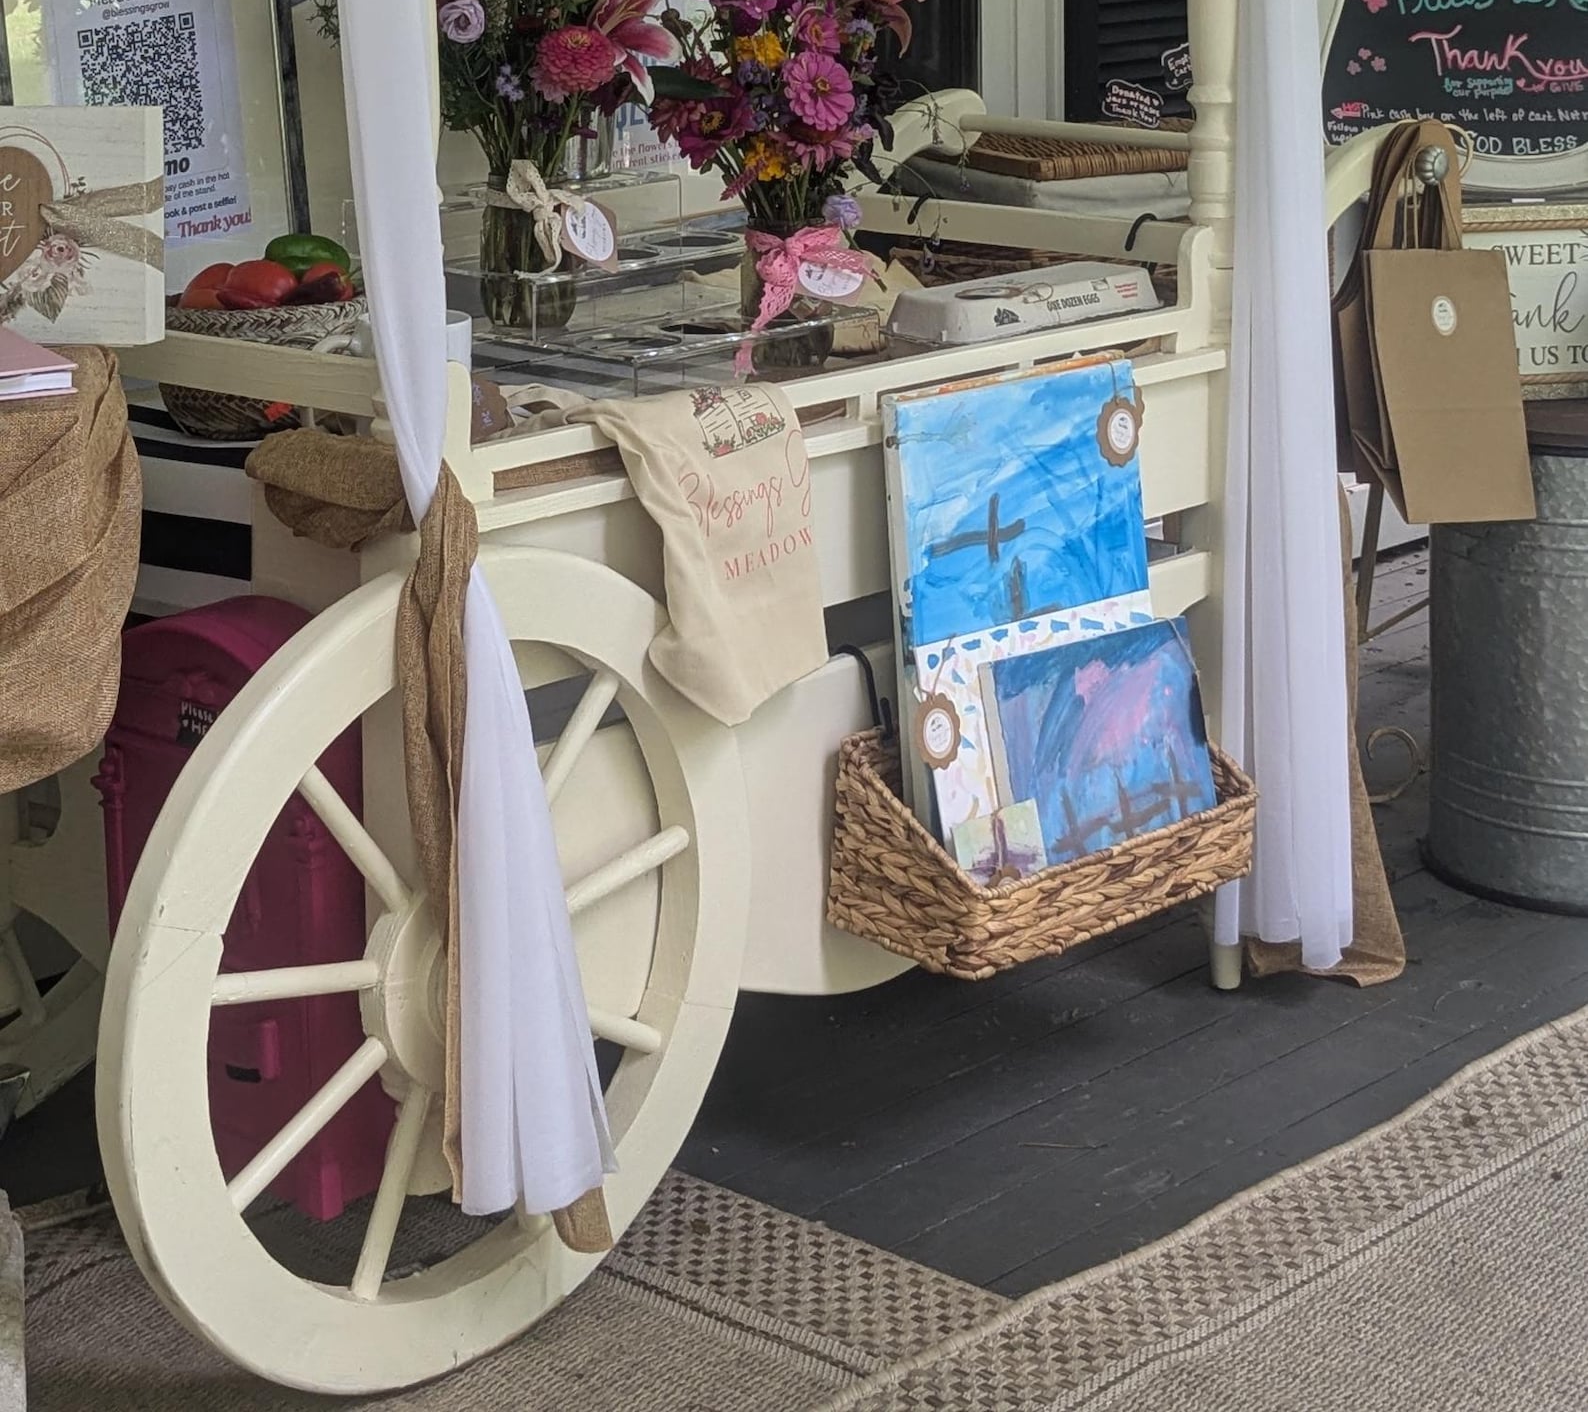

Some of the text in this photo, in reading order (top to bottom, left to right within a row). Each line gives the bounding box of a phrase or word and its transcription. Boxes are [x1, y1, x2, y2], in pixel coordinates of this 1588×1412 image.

[1112, 85, 1151, 105] Donated
[1361, 103, 1385, 119] Pink
[1484, 109, 1507, 122] left
[1512, 135, 1578, 155] BLESS
[177, 206, 252, 238] Thank you!
[1491, 243, 1580, 266] WEET
[1509, 271, 1586, 334] ank
[1530, 345, 1559, 366] US
[679, 472, 783, 538] Blessings
